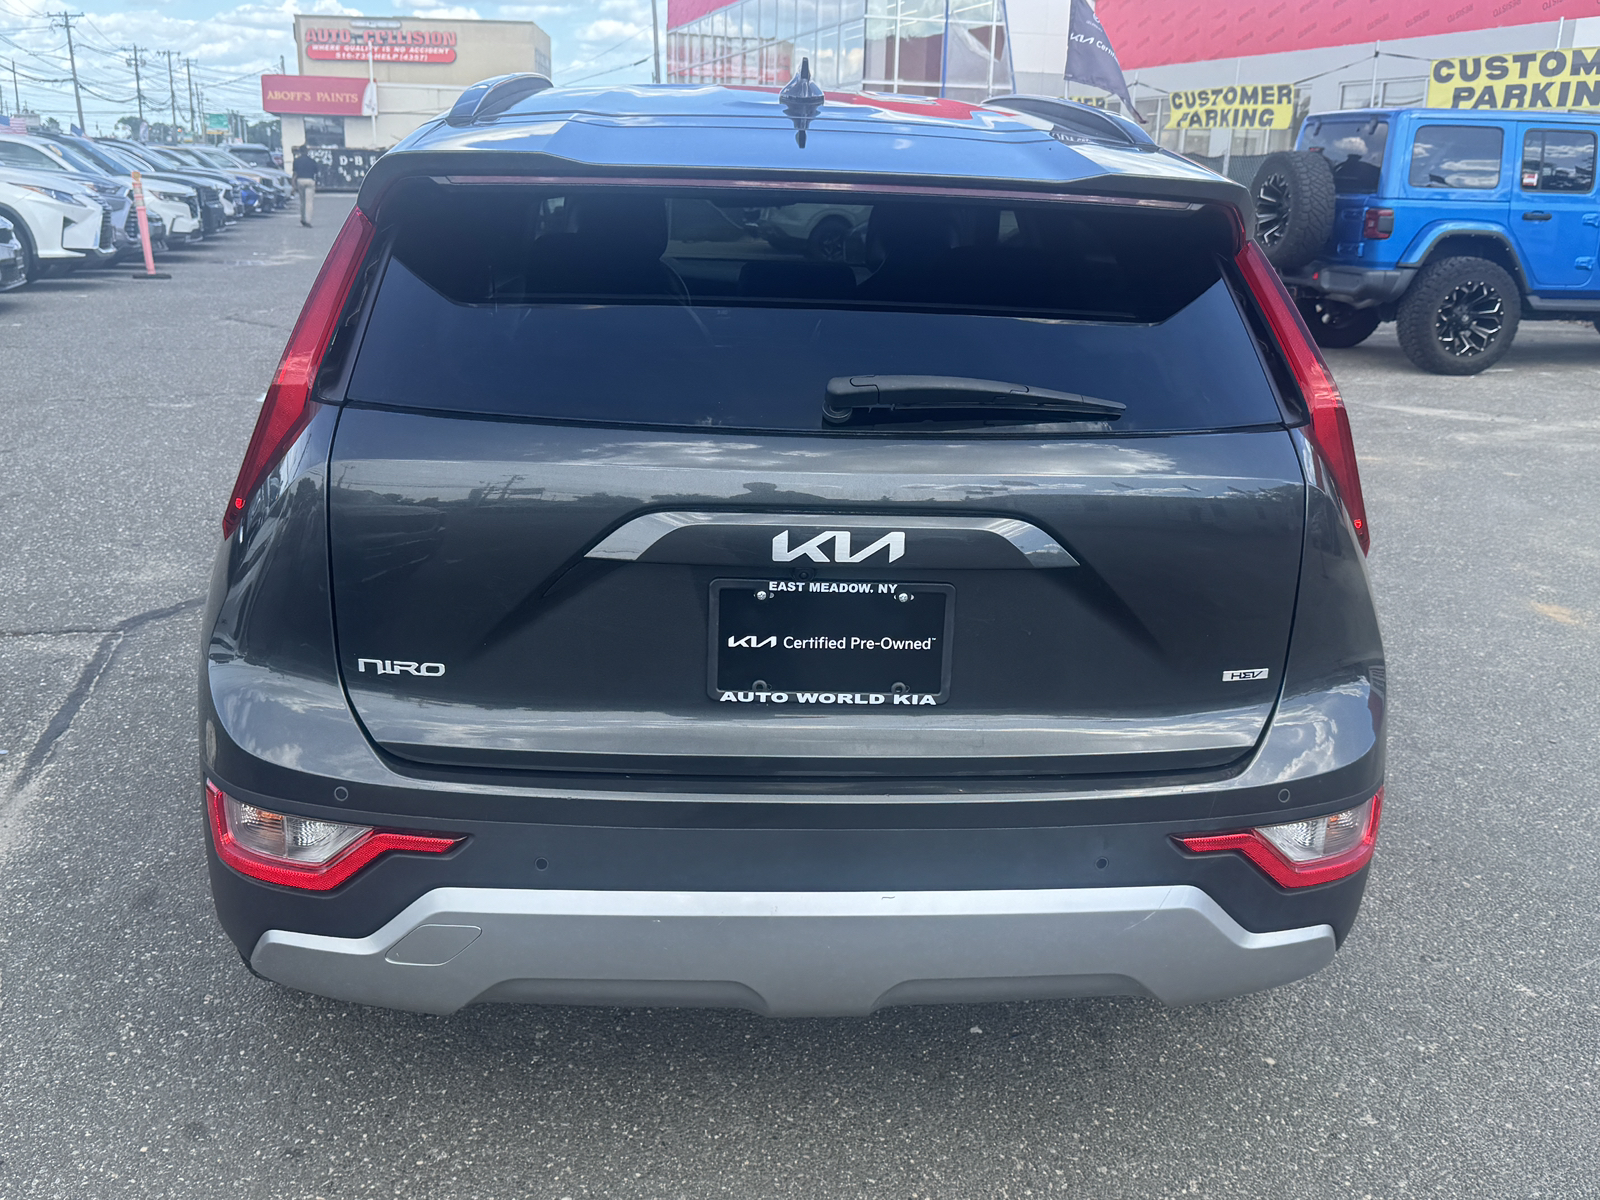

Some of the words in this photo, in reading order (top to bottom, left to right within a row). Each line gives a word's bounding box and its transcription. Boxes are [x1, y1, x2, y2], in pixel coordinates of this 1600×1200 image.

[305, 28, 351, 42] AUTO
[1070, 32, 1095, 45] KIA
[409, 47, 450, 55] ACCIDENT
[267, 90, 311, 101] ABOFF'S
[316, 92, 359, 103] PAINTS
[1171, 85, 1292, 109] CUSTOMER
[1176, 108, 1275, 128] PARKING
[772, 530, 905, 563] KIA
[769, 581, 805, 592] EAST
[878, 583, 898, 594] NY
[728, 635, 777, 648] KIA
[783, 636, 846, 650] Certified
[358, 658, 445, 677] NIRO
[1231, 670, 1264, 680] HEV
[719, 691, 788, 703] AUTO
[797, 692, 885, 705] WORLD
[893, 693, 937, 706] KIA
